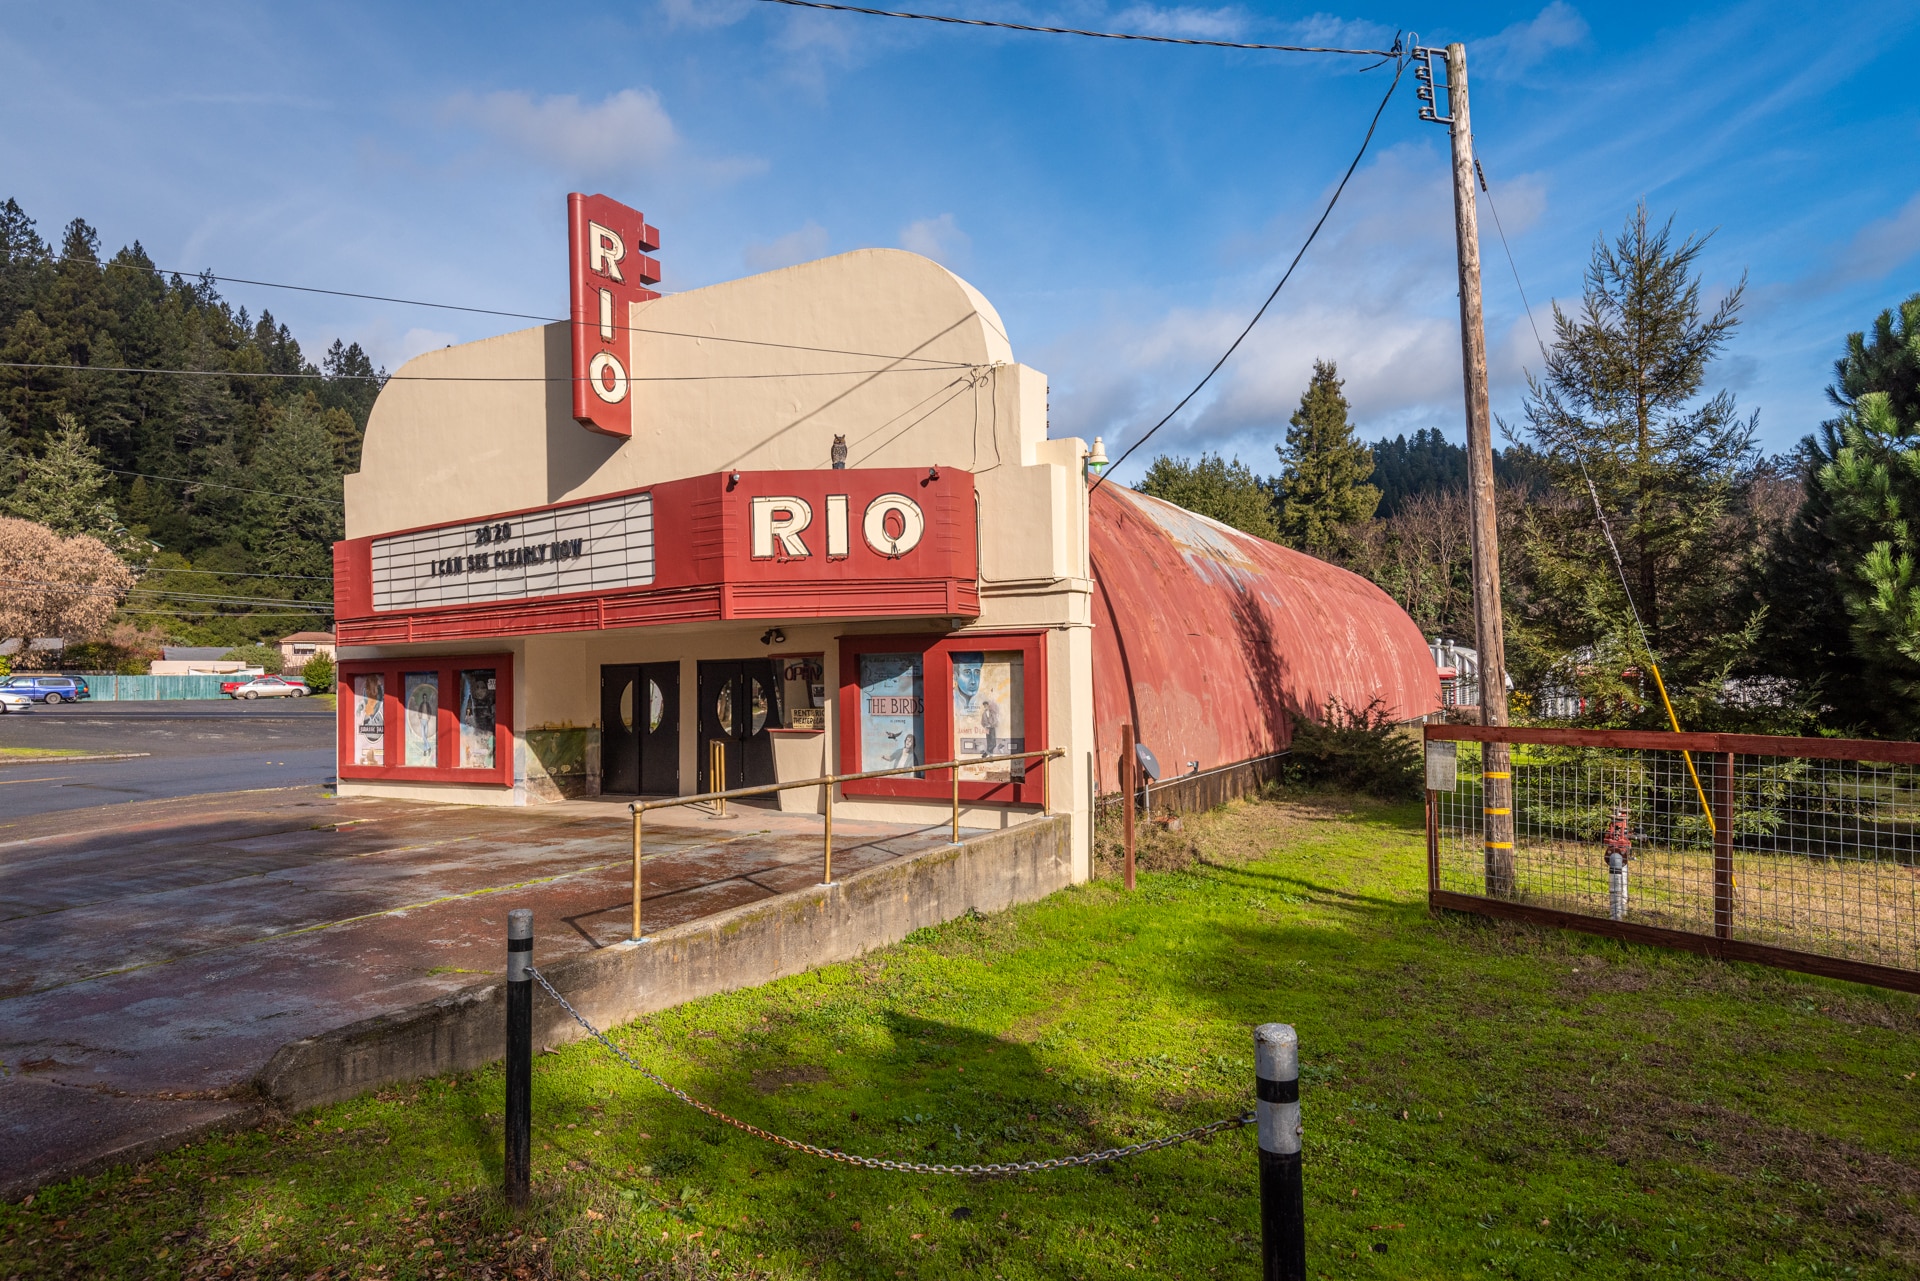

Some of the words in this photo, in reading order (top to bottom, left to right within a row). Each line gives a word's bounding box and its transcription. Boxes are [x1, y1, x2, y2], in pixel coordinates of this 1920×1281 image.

[588, 218, 628, 404] RIO
[751, 492, 926, 561] RIO
[438, 556, 462, 576] CAN
[467, 551, 489, 572] SEE
[494, 543, 546, 570] CLEARLY
[550, 537, 583, 564] NOW
[784, 665, 820, 681] OPEN
[793, 709, 811, 717] RENT
[867, 698, 886, 714] THE
[891, 698, 924, 714] BIRDS
[793, 717, 813, 725] THEATER
